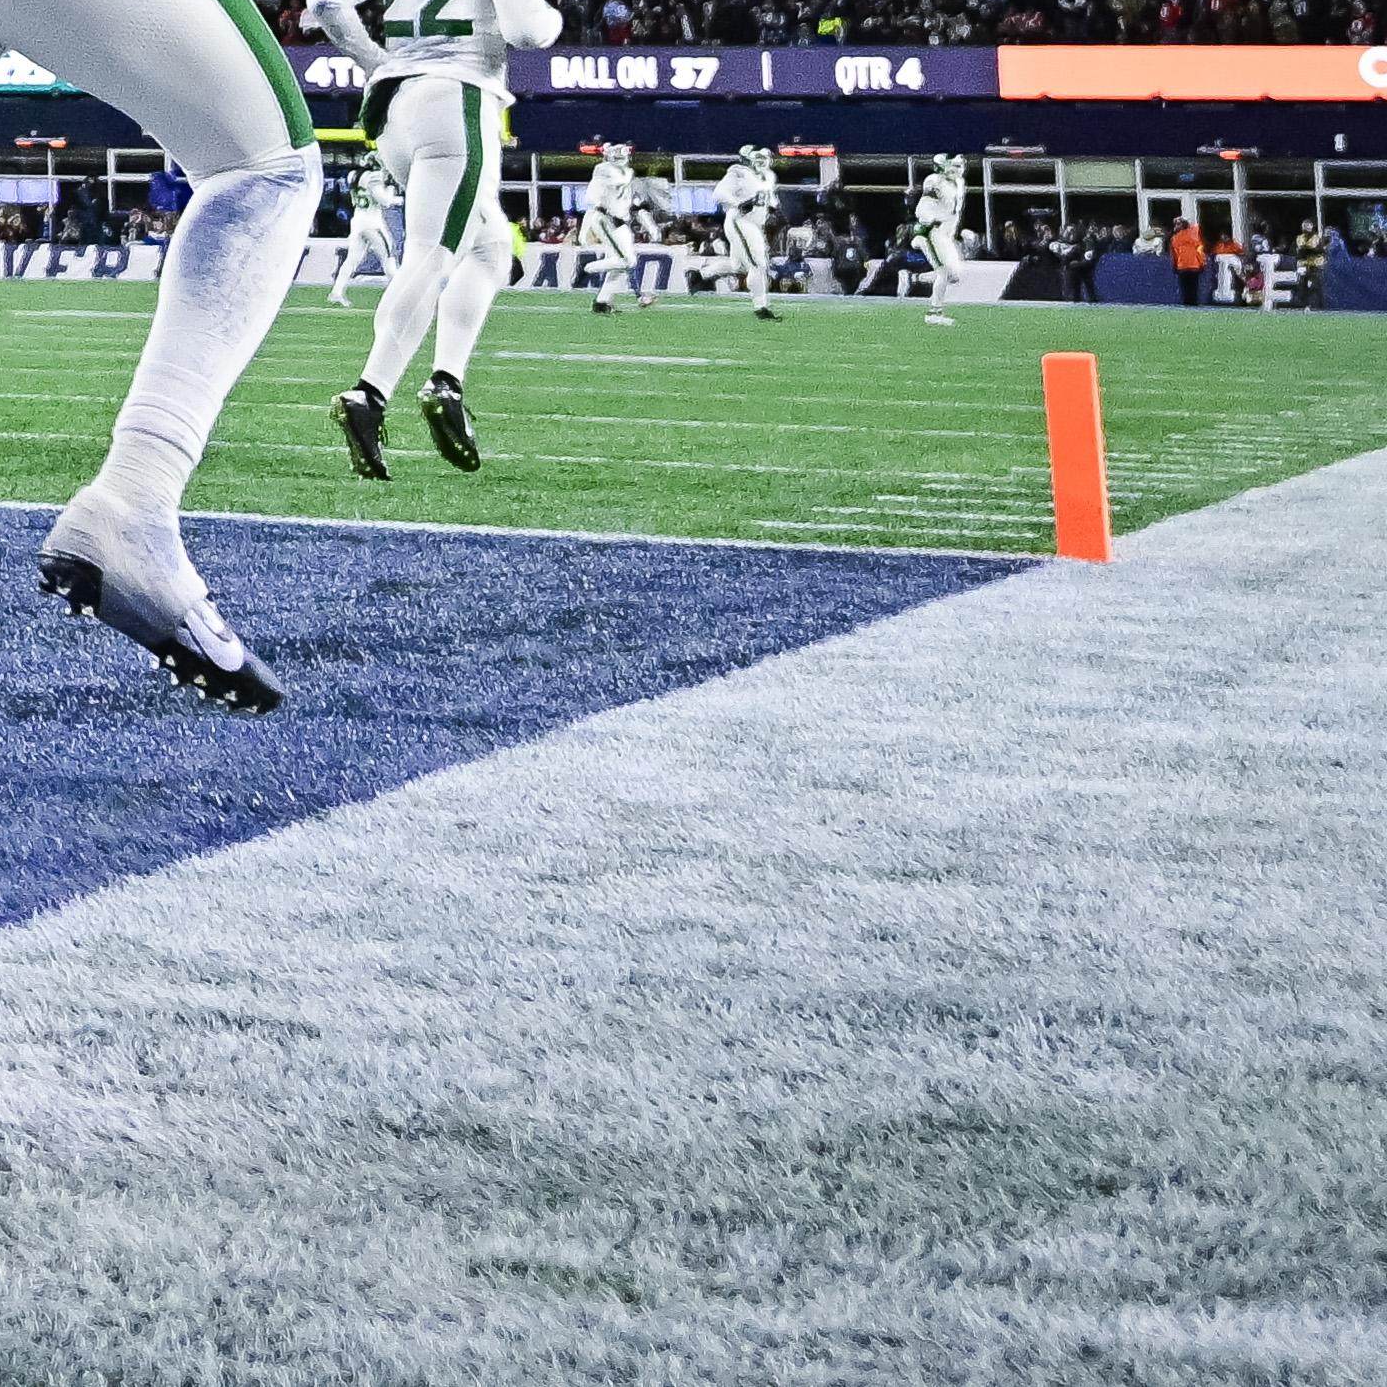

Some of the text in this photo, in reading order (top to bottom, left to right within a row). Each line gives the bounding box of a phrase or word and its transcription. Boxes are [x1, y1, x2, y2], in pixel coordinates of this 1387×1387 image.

[550, 56, 721, 89] BALL ON 37
[834, 56, 926, 95] QTR 4
